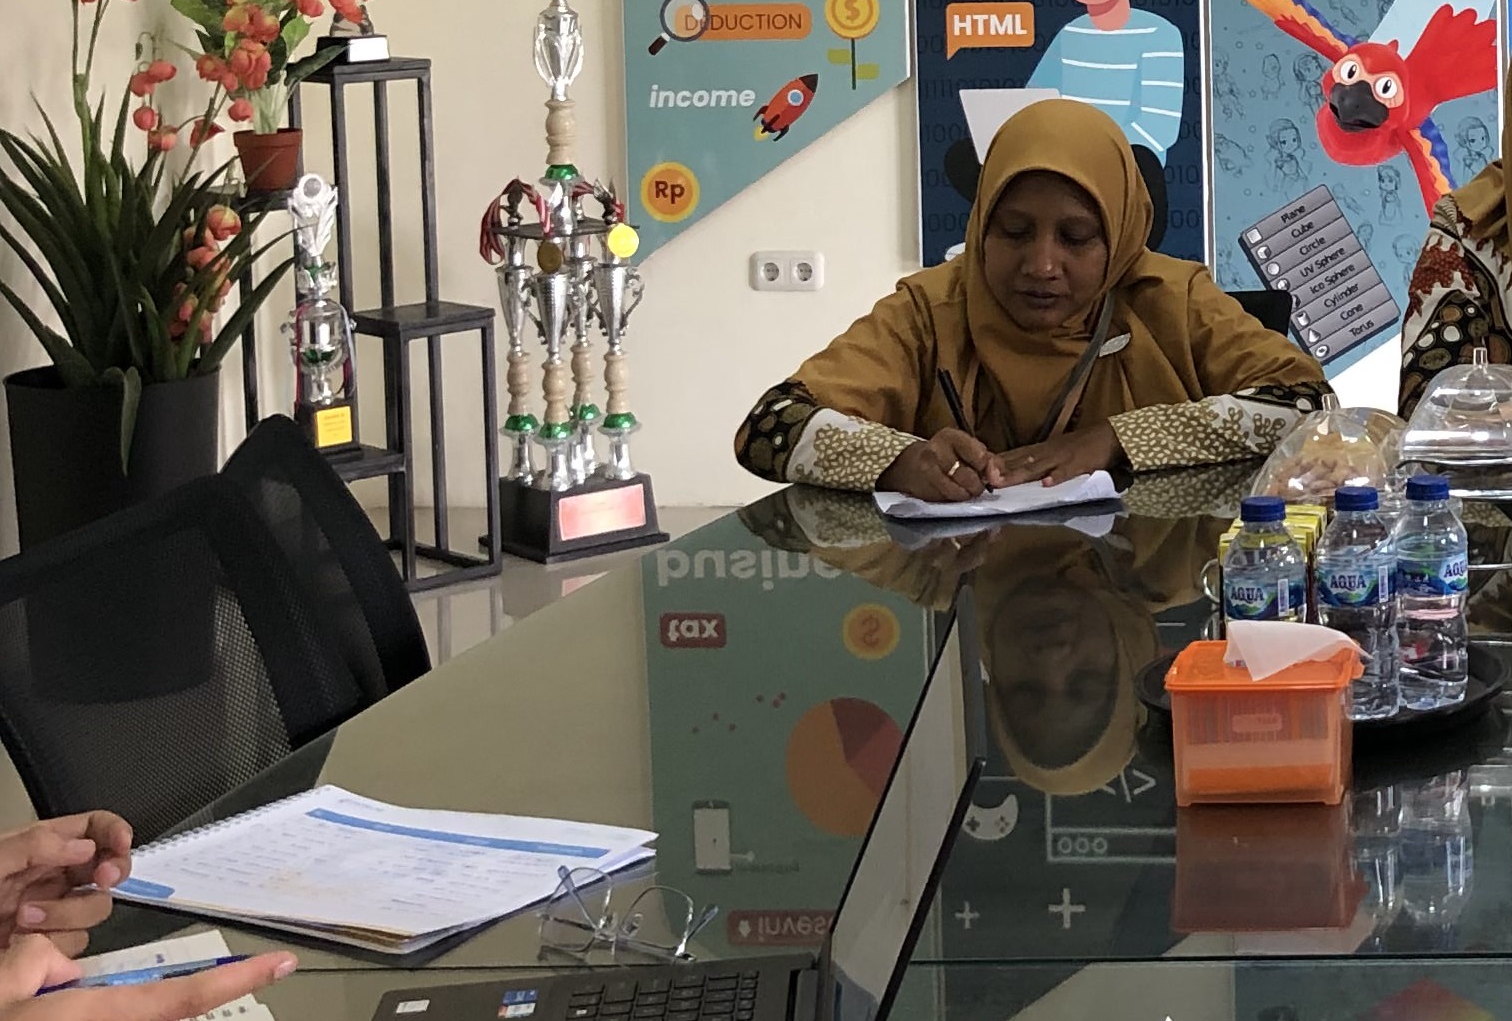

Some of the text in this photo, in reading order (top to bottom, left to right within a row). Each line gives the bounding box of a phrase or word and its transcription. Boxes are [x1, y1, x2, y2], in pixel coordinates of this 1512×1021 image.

[953, 13, 1028, 37] HTML
[649, 84, 756, 109] income
[655, 180, 686, 204] Rp
[1281, 206, 1306, 223] Plane
[1291, 220, 1315, 239] Cube
[1299, 236, 1326, 256] Circle
[1300, 248, 1346, 278] UV Sphere
[1325, 265, 1355, 287] Sphere
[1324, 284, 1359, 308] Cylinder
[1340, 303, 1364, 320] Cone
[1349, 320, 1375, 337] Torus
[1329, 573, 1367, 593] AQUA
[1230, 586, 1265, 604] AQUA
